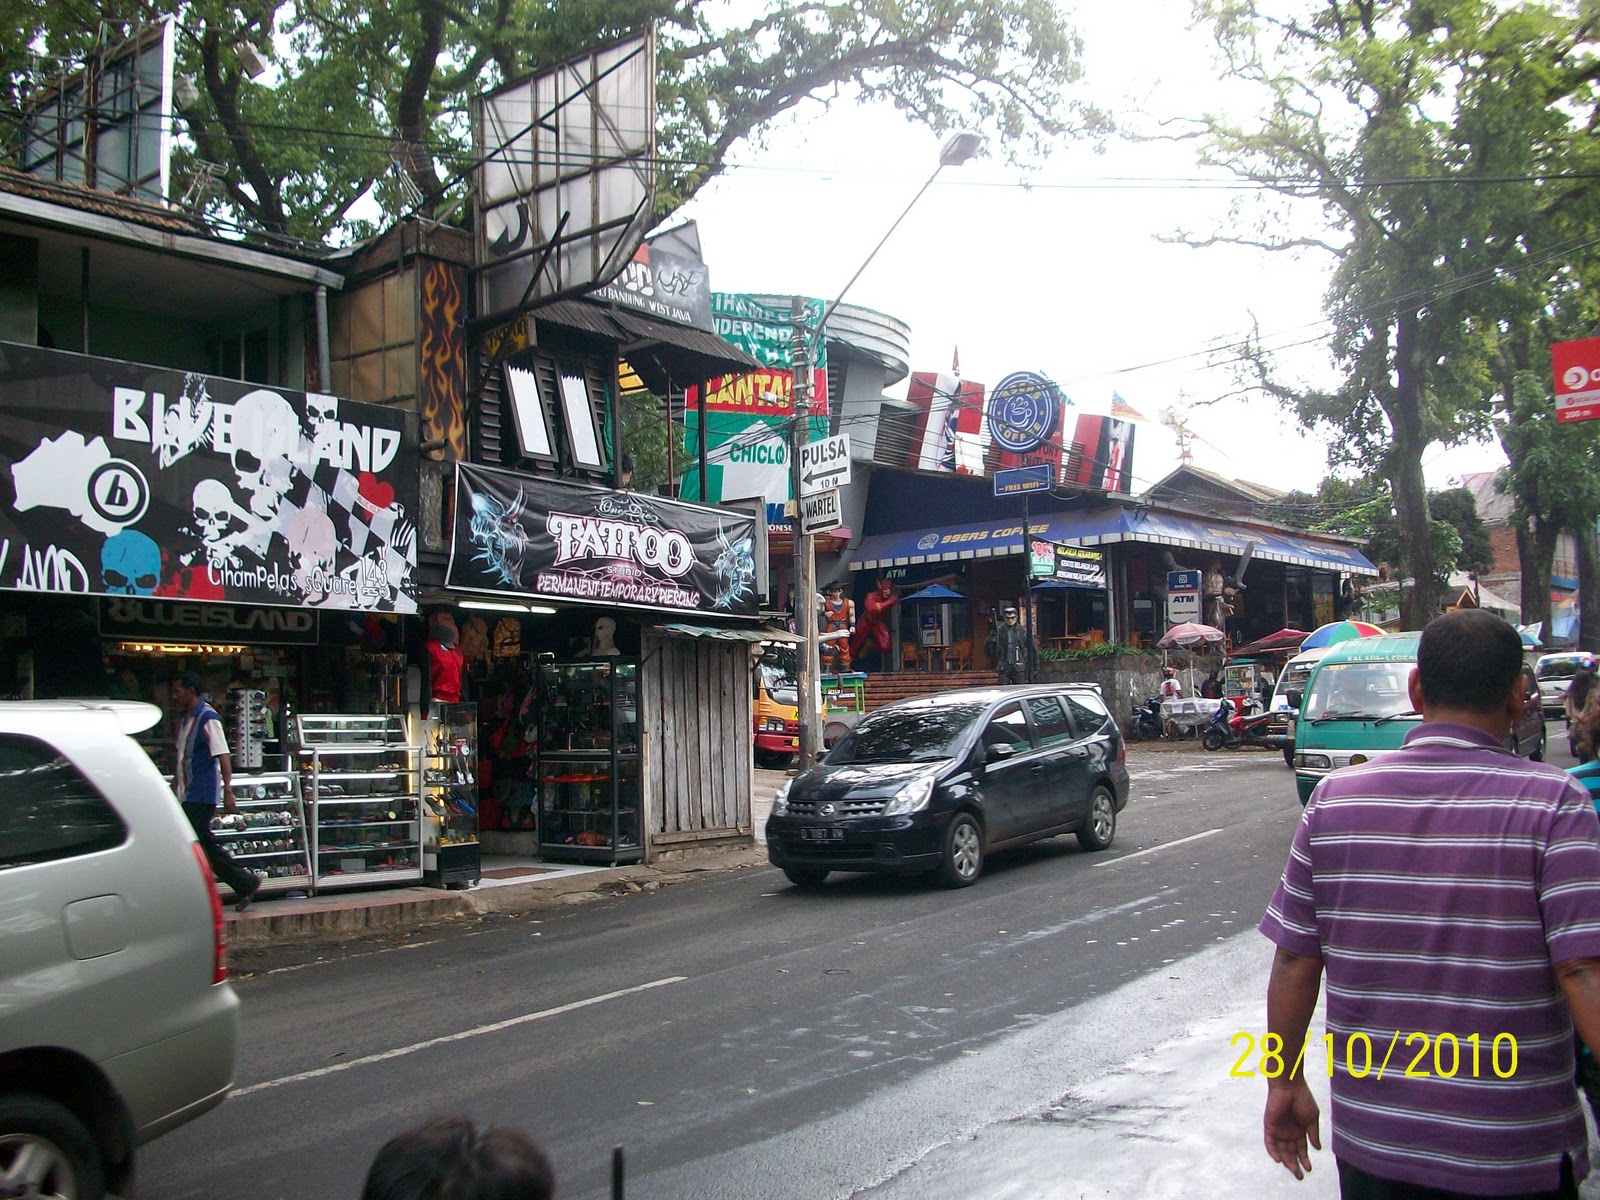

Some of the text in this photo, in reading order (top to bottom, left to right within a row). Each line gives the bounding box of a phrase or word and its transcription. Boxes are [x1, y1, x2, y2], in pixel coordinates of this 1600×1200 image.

[608, 289, 646, 308] BANDUNG
[648, 300, 670, 315] WEST
[672, 307, 692, 323] JAVA
[730, 442, 785, 465] CHICLO
[802, 438, 847, 468] PULSA
[1005, 481, 1040, 492] FREE WIFI
[805, 496, 837, 519] WARTEL
[548, 511, 700, 578] TATTOO
[940, 531, 989, 545] 99ERS
[606, 565, 642, 578] STUDIO
[886, 569, 906, 579] ATM
[1173, 595, 1194, 603] ATM
